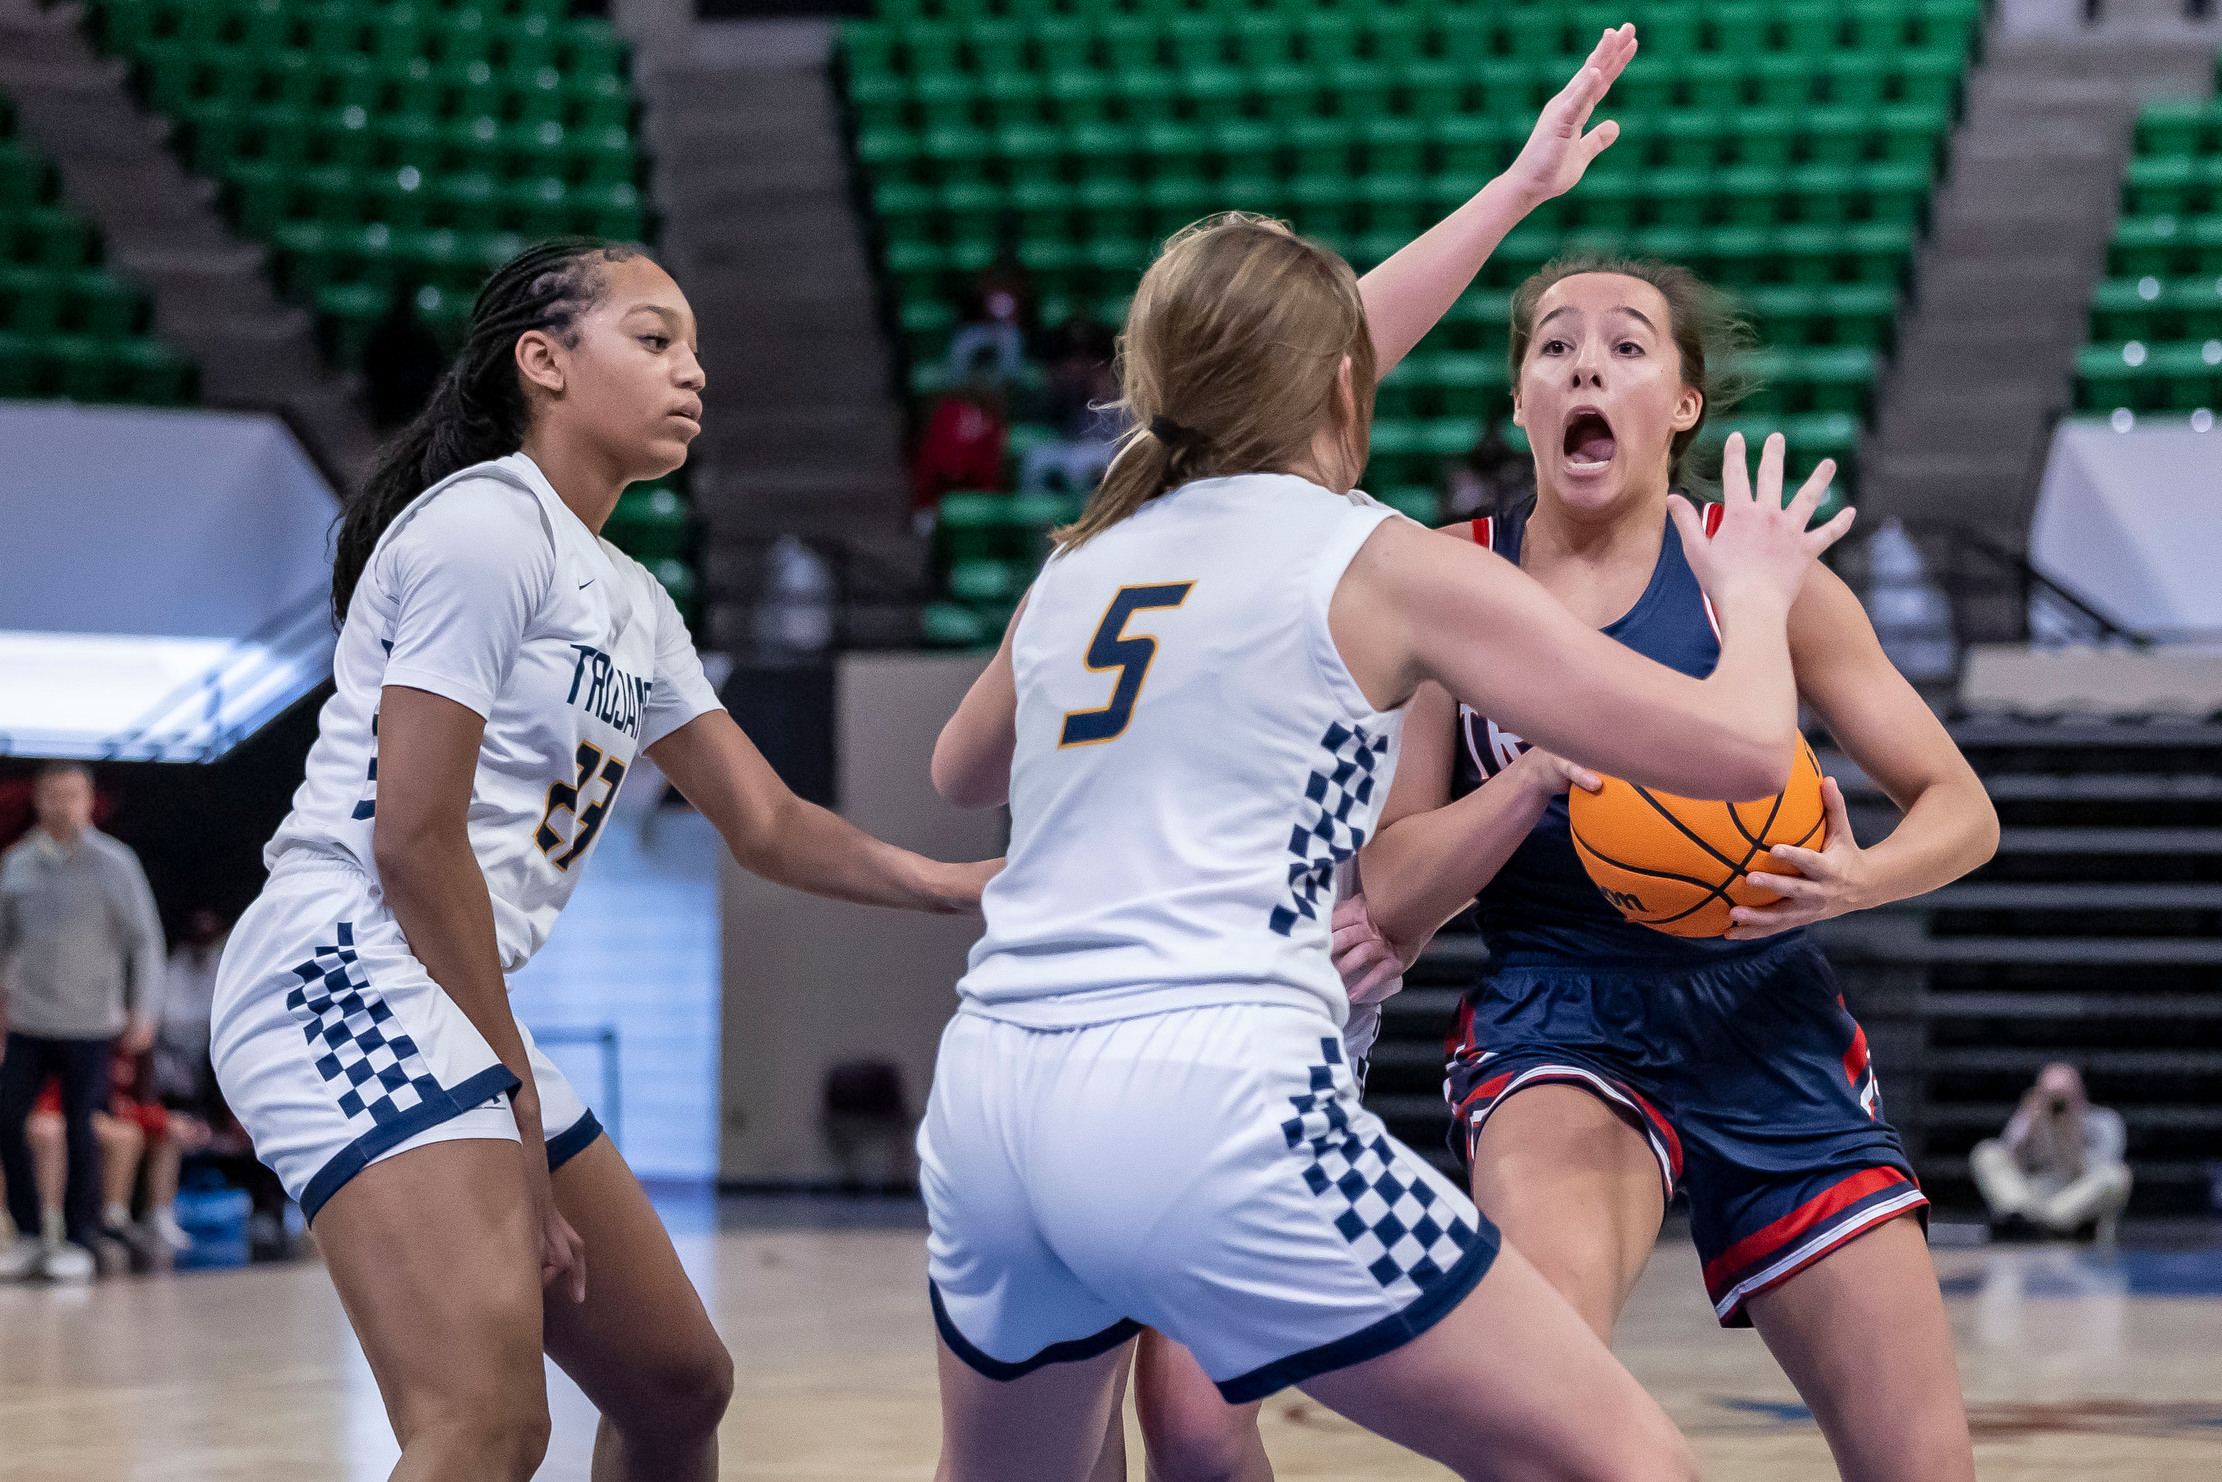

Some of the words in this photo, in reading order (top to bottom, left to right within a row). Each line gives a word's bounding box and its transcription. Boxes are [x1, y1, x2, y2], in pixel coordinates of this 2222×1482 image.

[566, 643, 653, 740] TROJAN
[1057, 579, 1198, 750] 5
[532, 739, 626, 873] 23
